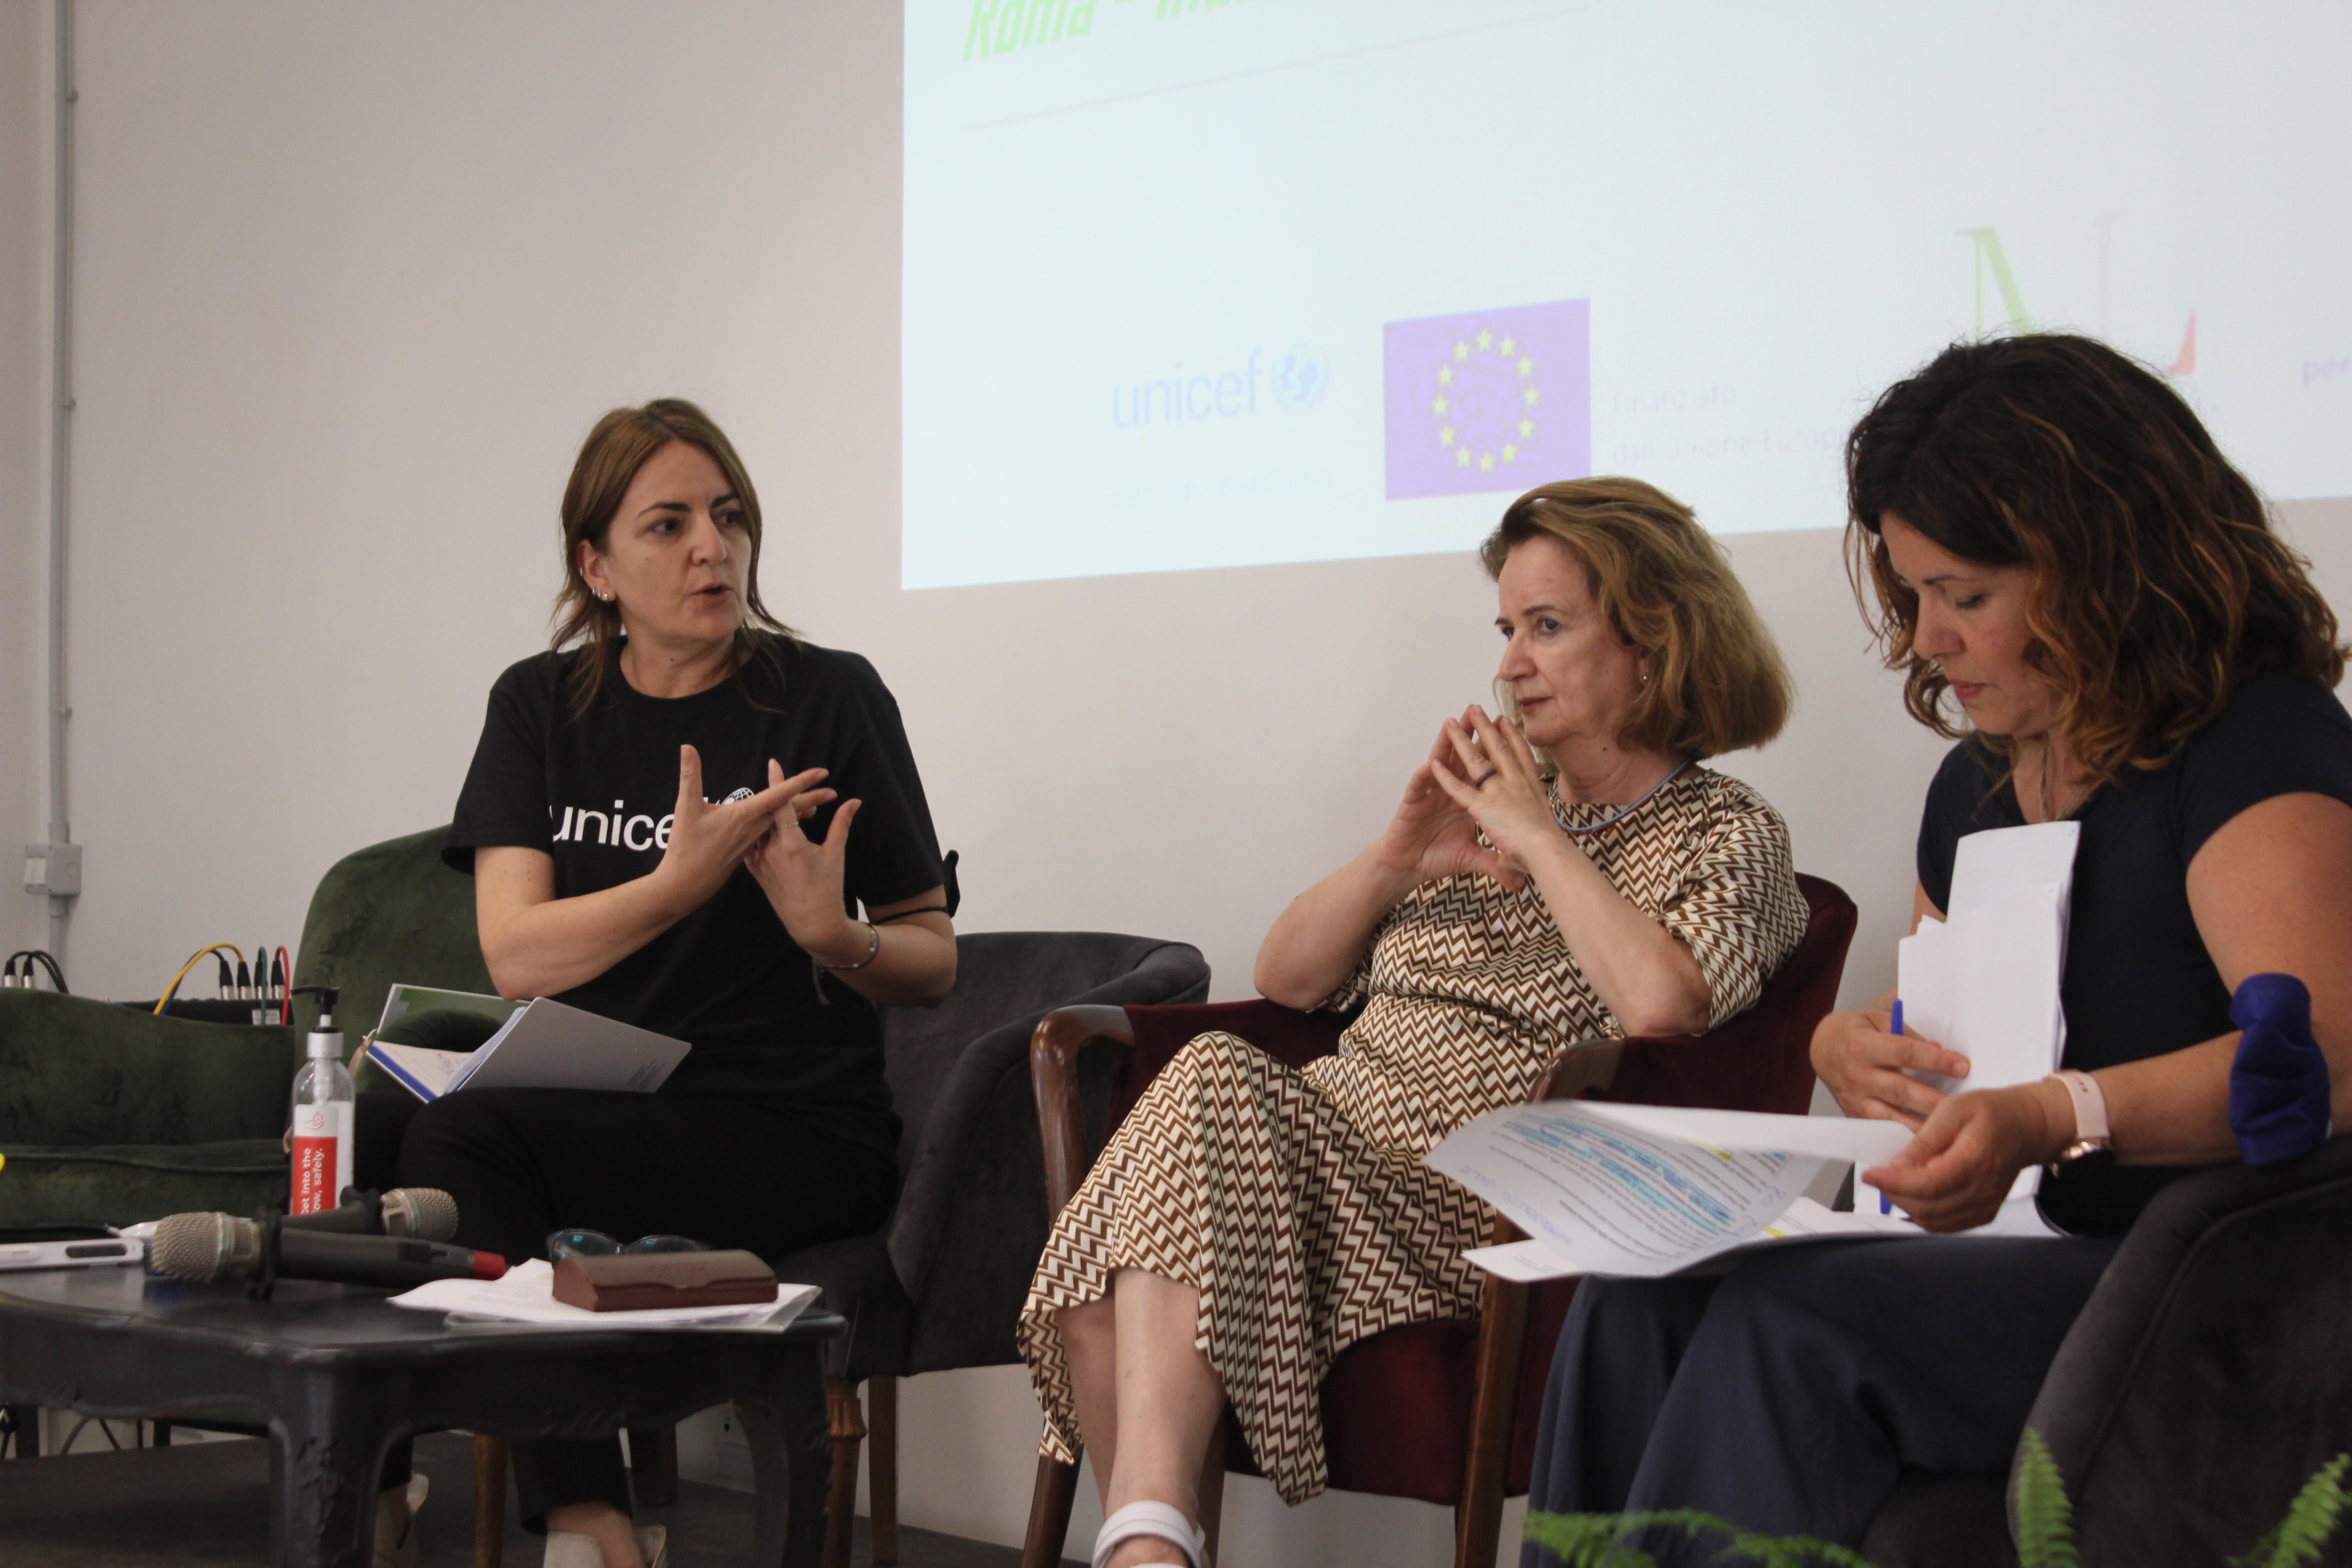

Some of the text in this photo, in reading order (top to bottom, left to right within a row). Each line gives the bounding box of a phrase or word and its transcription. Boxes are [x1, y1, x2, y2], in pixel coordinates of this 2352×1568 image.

[963, 0, 1096, 62] Roma
[1113, 347, 1264, 429] unicef
[549, 797, 709, 851] unice
[303, 1147, 311, 1167] the
[313, 1148, 324, 1186] safely.
[302, 1171, 311, 1194] into
